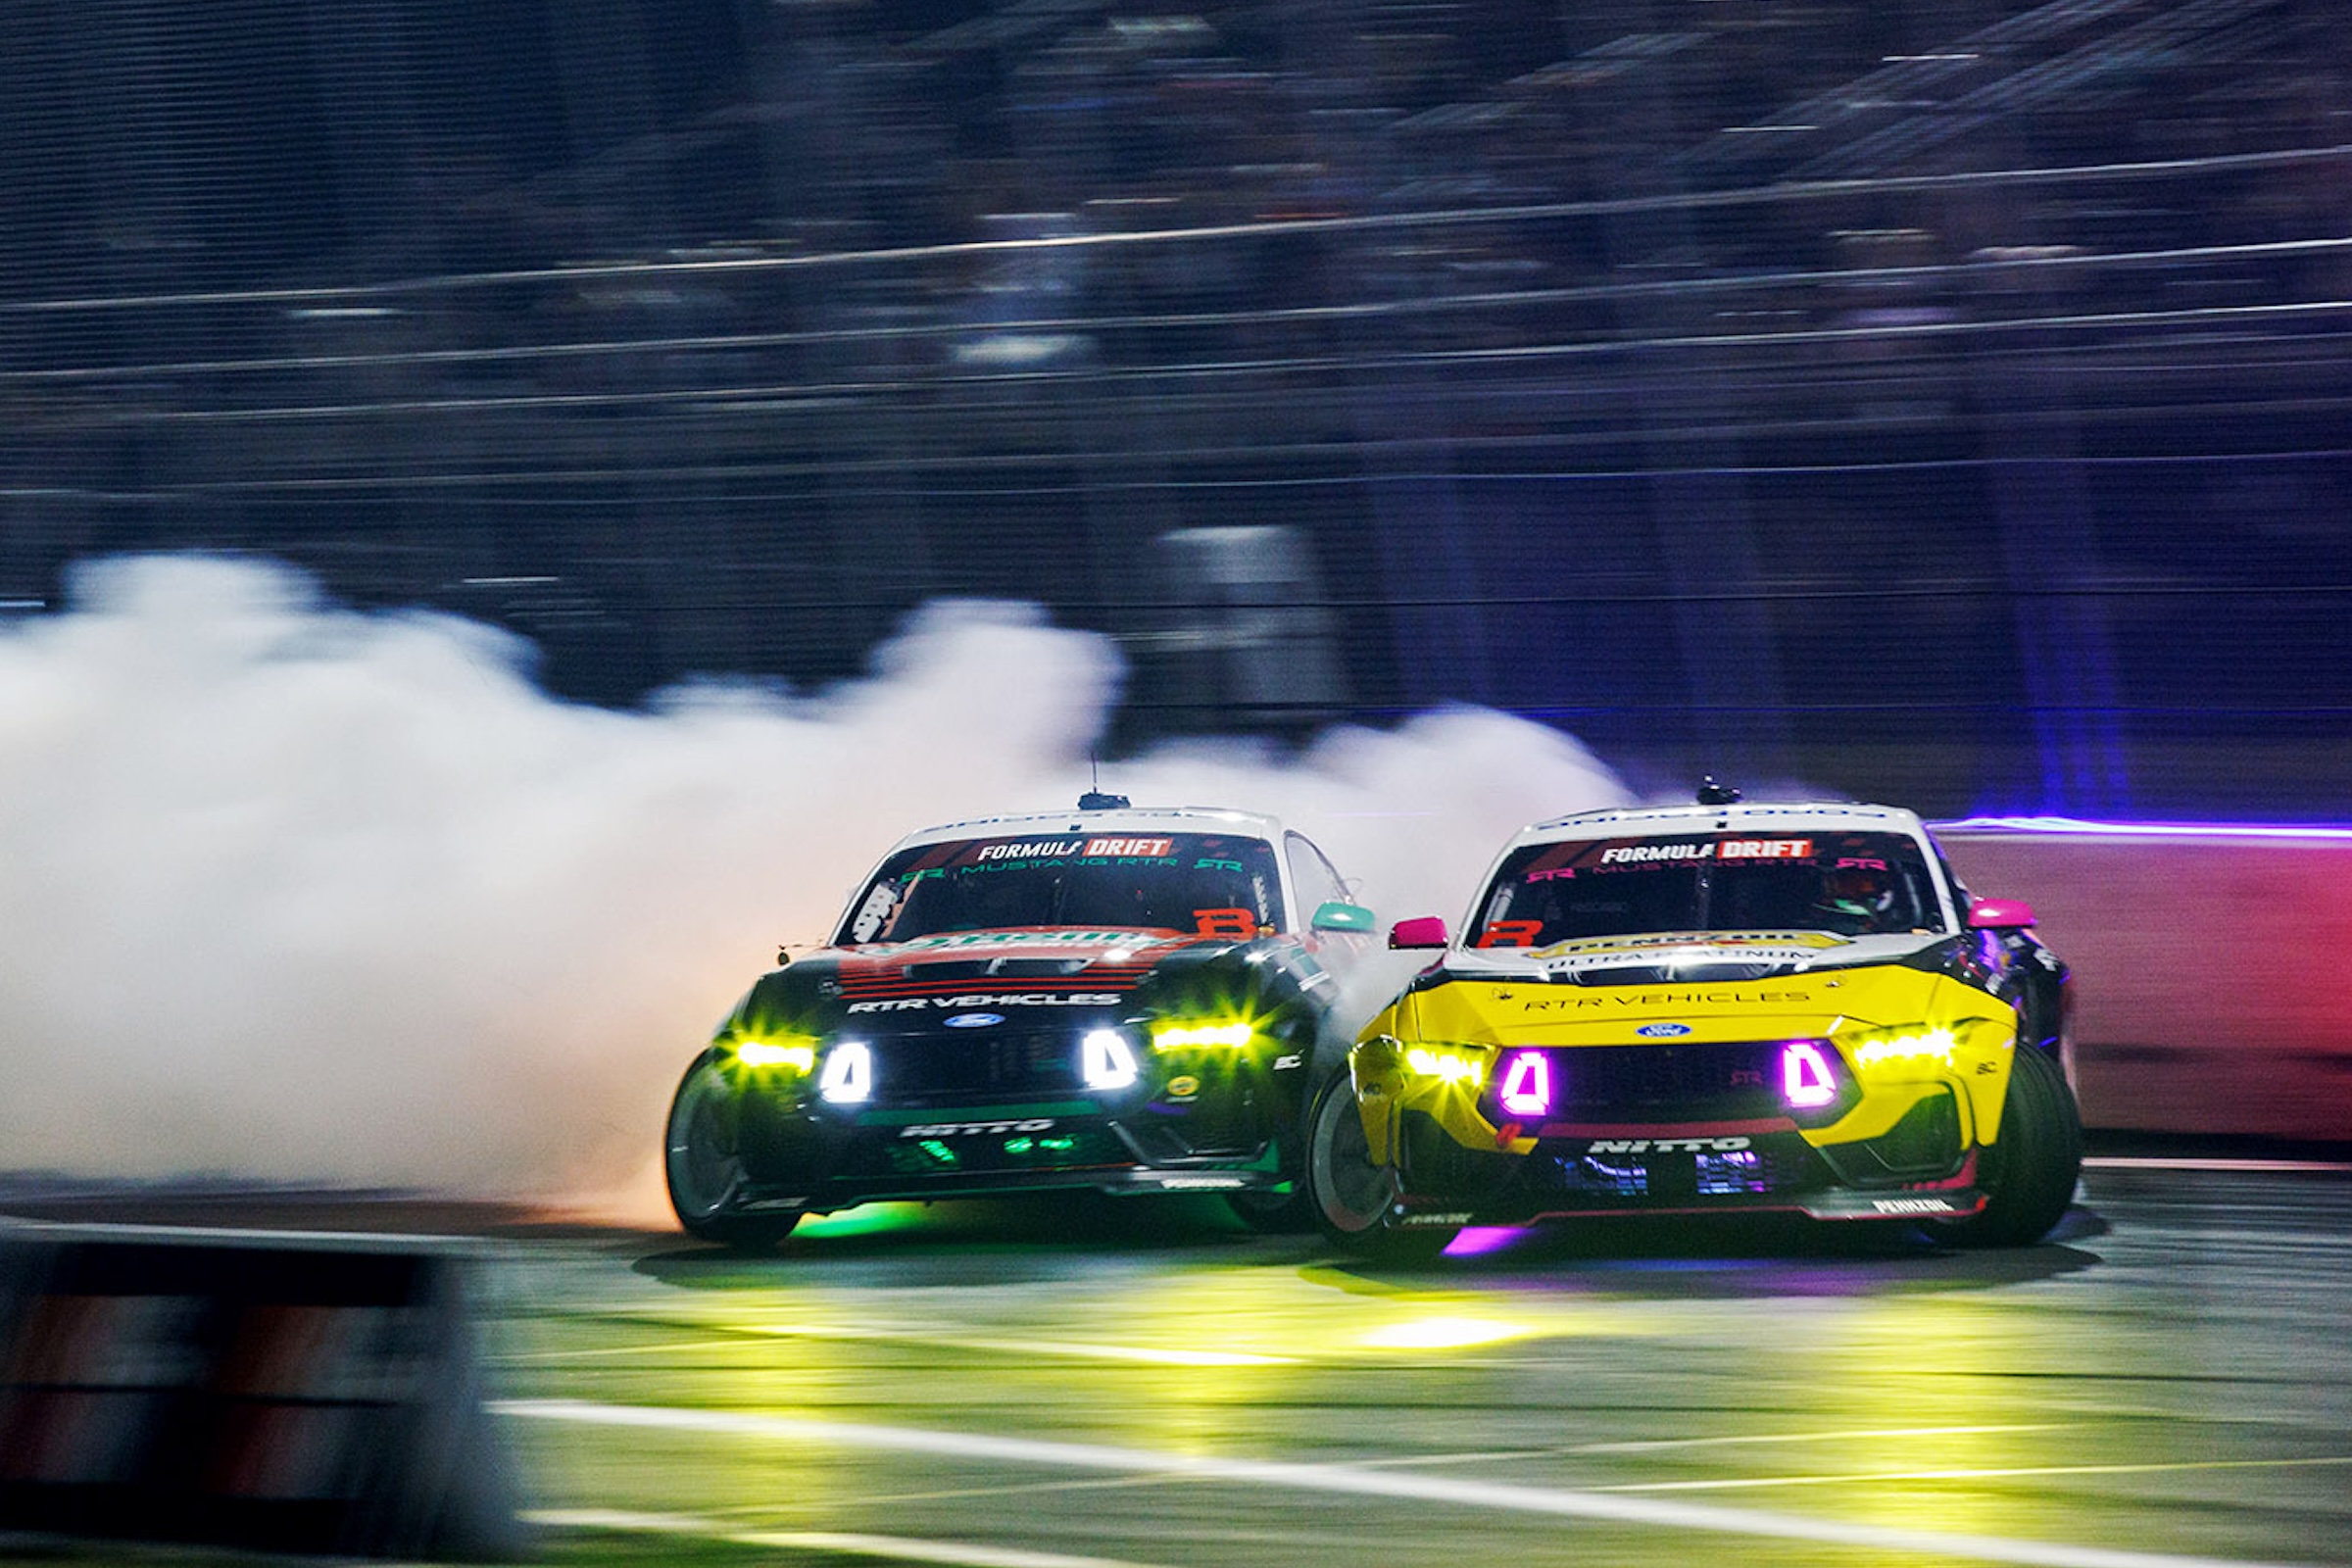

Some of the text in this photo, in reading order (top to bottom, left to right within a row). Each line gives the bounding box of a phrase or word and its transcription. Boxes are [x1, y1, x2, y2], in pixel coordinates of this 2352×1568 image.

[978, 838, 1169, 860] FORMULA DRIFT
[1600, 840, 1809, 863] FORMULA DRIFT
[960, 857, 1180, 874] MUSTANG RTR
[1754, 858, 1818, 867] RTR
[1547, 949, 1816, 969] ULTRA PATINUM
[847, 993, 1122, 1015] RTR VEHICLES
[1524, 991, 1811, 1011] RTR VEHICLES
[899, 1118, 1054, 1138] NITTO
[1588, 1137, 1751, 1153] NITTO
[1872, 1199, 1955, 1215] PENNZOIL
